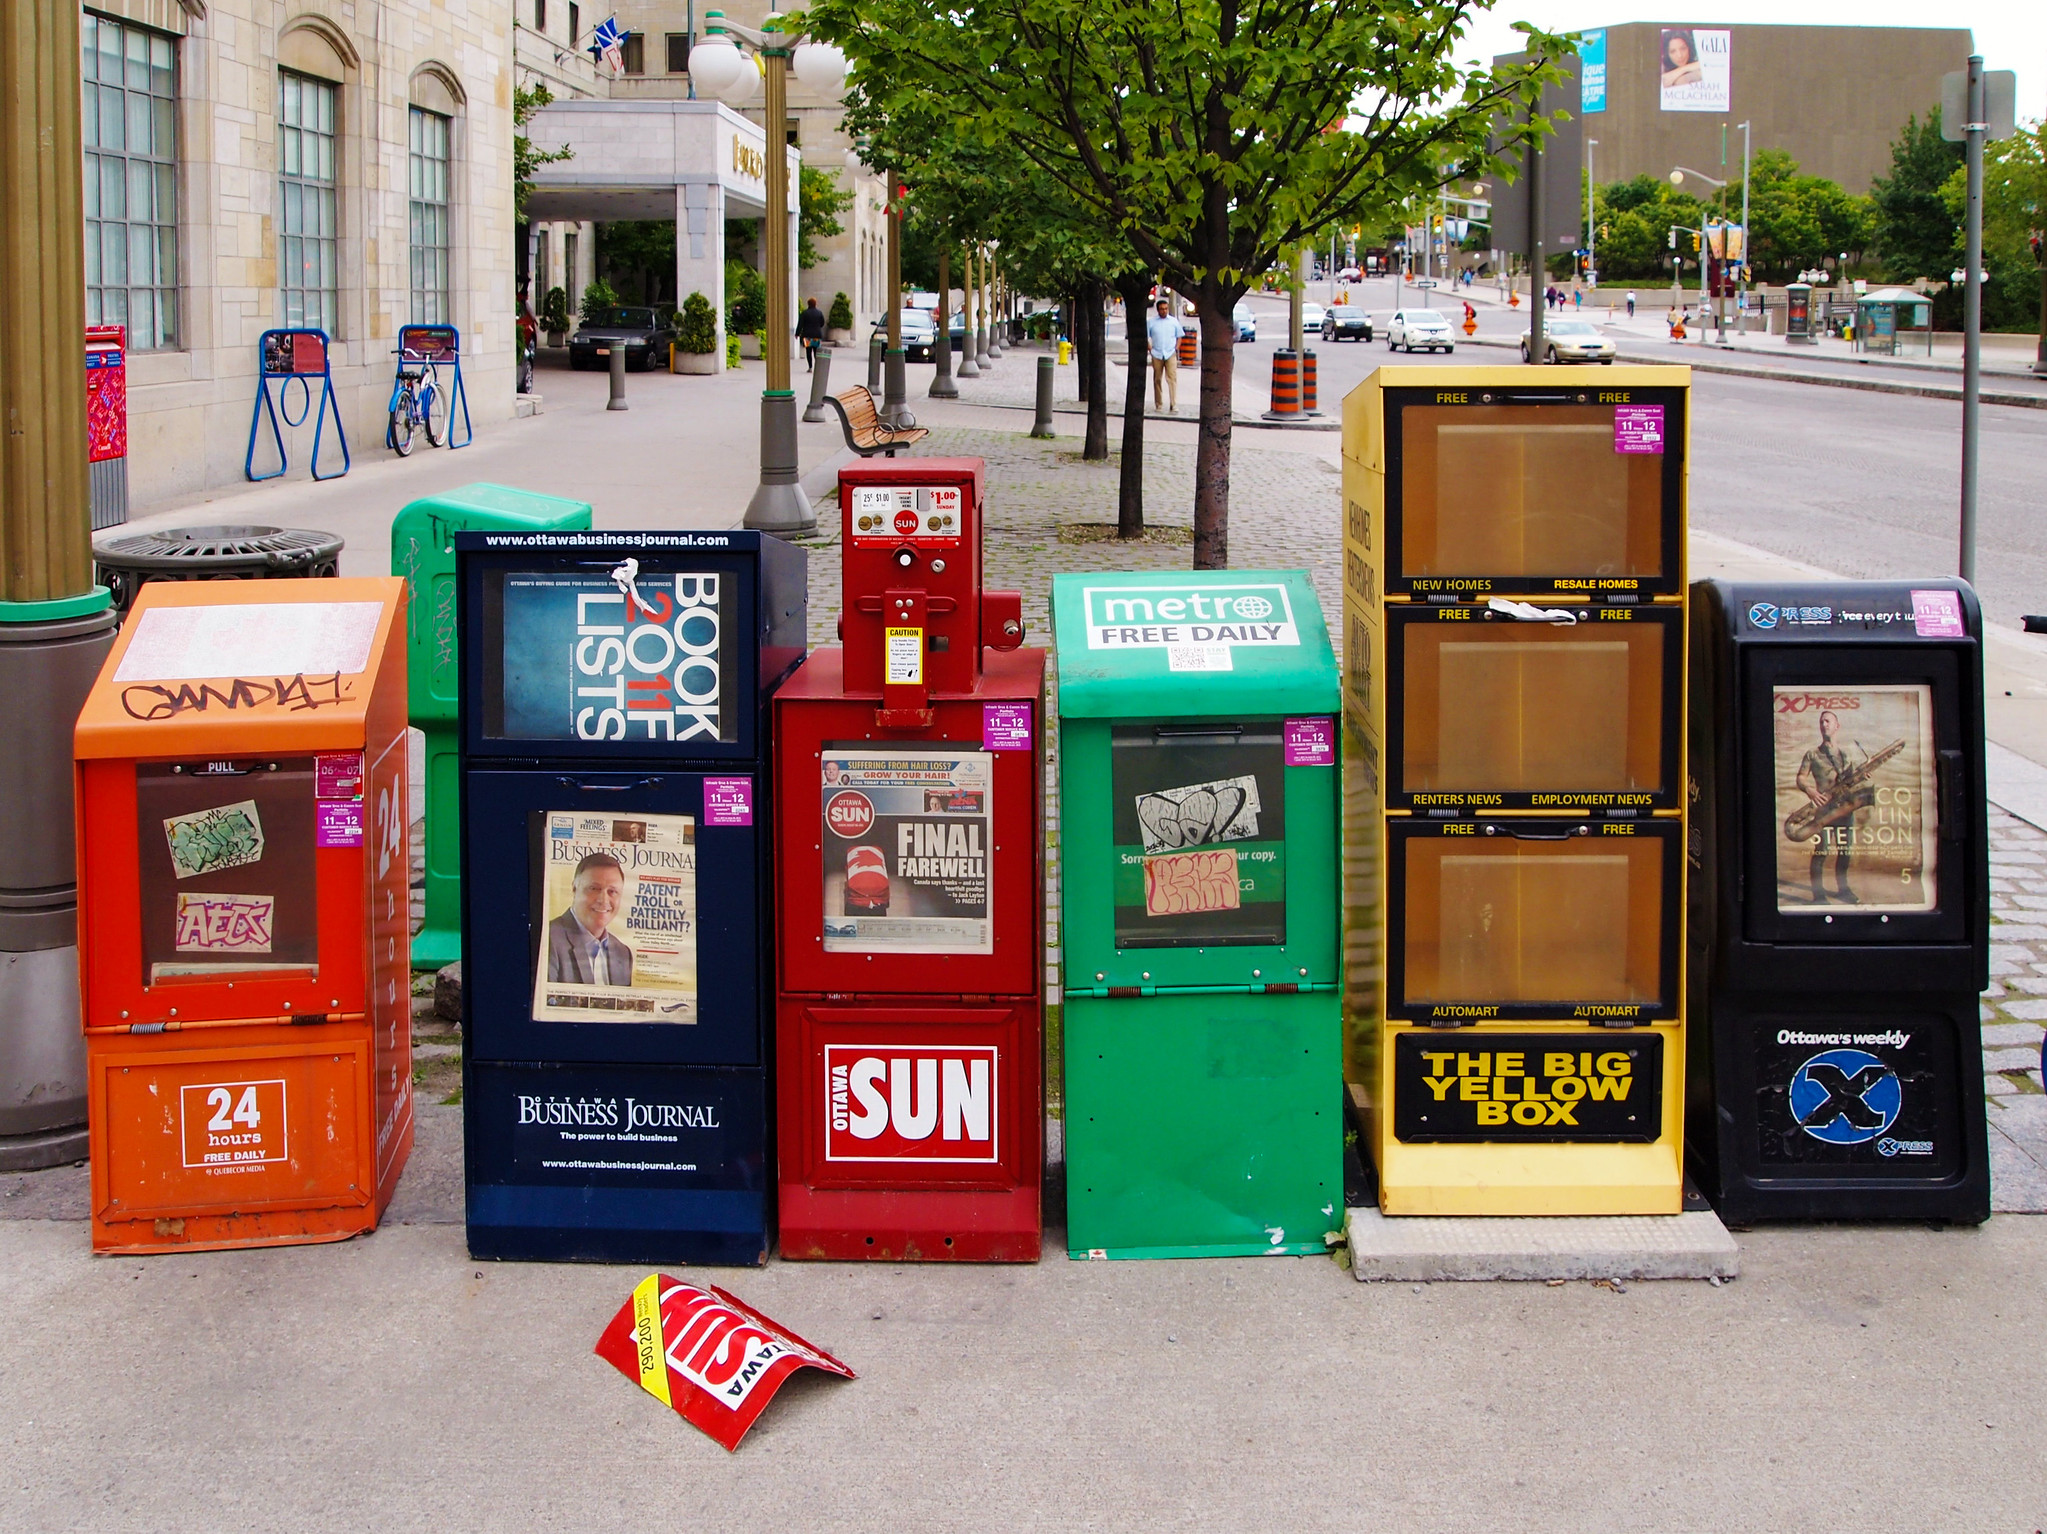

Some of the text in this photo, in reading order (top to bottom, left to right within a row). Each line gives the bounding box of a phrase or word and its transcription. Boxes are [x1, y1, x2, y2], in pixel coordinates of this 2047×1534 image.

[1701, 36, 1728, 53] GALA
[1689, 81, 1720, 91] SARAH
[1436, 392, 1468, 403] FREE
[1599, 392, 1631, 403] FREE
[1622, 421, 1656, 431] 11 12
[930, 491, 956, 504] $1.00
[895, 520, 916, 528] SUN
[486, 533, 729, 547] www.ottawabusinessjournal.com
[1413, 580, 1492, 590] NEW HOMES
[1554, 580, 1638, 589] RESALE HOMES
[1439, 609, 1470, 620] FREE
[1600, 609, 1632, 620] FREE
[1920, 606, 1952, 615] 11 12
[1102, 625, 1282, 644] FREE DAILY
[674, 573, 720, 741] BOOK
[577, 593, 626, 740] LISTS
[990, 717, 1024, 727] 11 12
[1291, 732, 1324, 742] 11 12
[208, 762, 235, 773] PULL
[848, 762, 951, 770] SUFFERING FROM HAIR LOSS?
[711, 793, 744, 803] 11 12
[1413, 794, 1502, 805] RENTERS NEWS
[1532, 794, 1652, 805] EMPLOYMENT NEWS
[1876, 787, 1912, 805] CO
[324, 816, 358, 825] 11 12
[830, 807, 870, 822] SUN
[1879, 807, 1913, 824] LIN
[378, 773, 401, 880] 24
[1443, 824, 1475, 835] FREE
[1603, 824, 1635, 835] FREE
[898, 823, 984, 857] FINAL
[631, 845, 695, 869] JOURNA
[1252, 850, 1276, 862] copy.
[898, 857, 985, 878] FAREWELL
[1901, 868, 1912, 885] 5
[638, 883, 681, 897] PATENT
[635, 895, 670, 908] TROLL
[631, 907, 686, 920] PATENTLY
[627, 918, 690, 932] BRILLIANT?
[1432, 1006, 1499, 1017] AUTOMART
[1574, 1006, 1640, 1016] AUTOMART
[1777, 1029, 1911, 1049] Ottawa's weekly
[1423, 1052, 1632, 1077] THE BIG
[1422, 1076, 1633, 1101] YELLOW
[832, 1065, 848, 1131] OTTAWA
[850, 1057, 990, 1141] SUN
[207, 1086, 261, 1131] 24
[518, 1096, 720, 1132] BUSINESS JOURNAL
[1477, 1101, 1579, 1125] BOX
[208, 1133, 262, 1146] hours
[560, 1132, 576, 1140] The
[578, 1133, 605, 1141] power
[617, 1133, 639, 1141] build
[640, 1134, 678, 1142] business
[204, 1150, 266, 1162] FREE DAILY
[213, 1165, 266, 1176] QUEBECOR MEDIA
[542, 1160, 697, 1171] www.ottawabusinessjournal.com
[638, 1317, 654, 1375] 290,200
